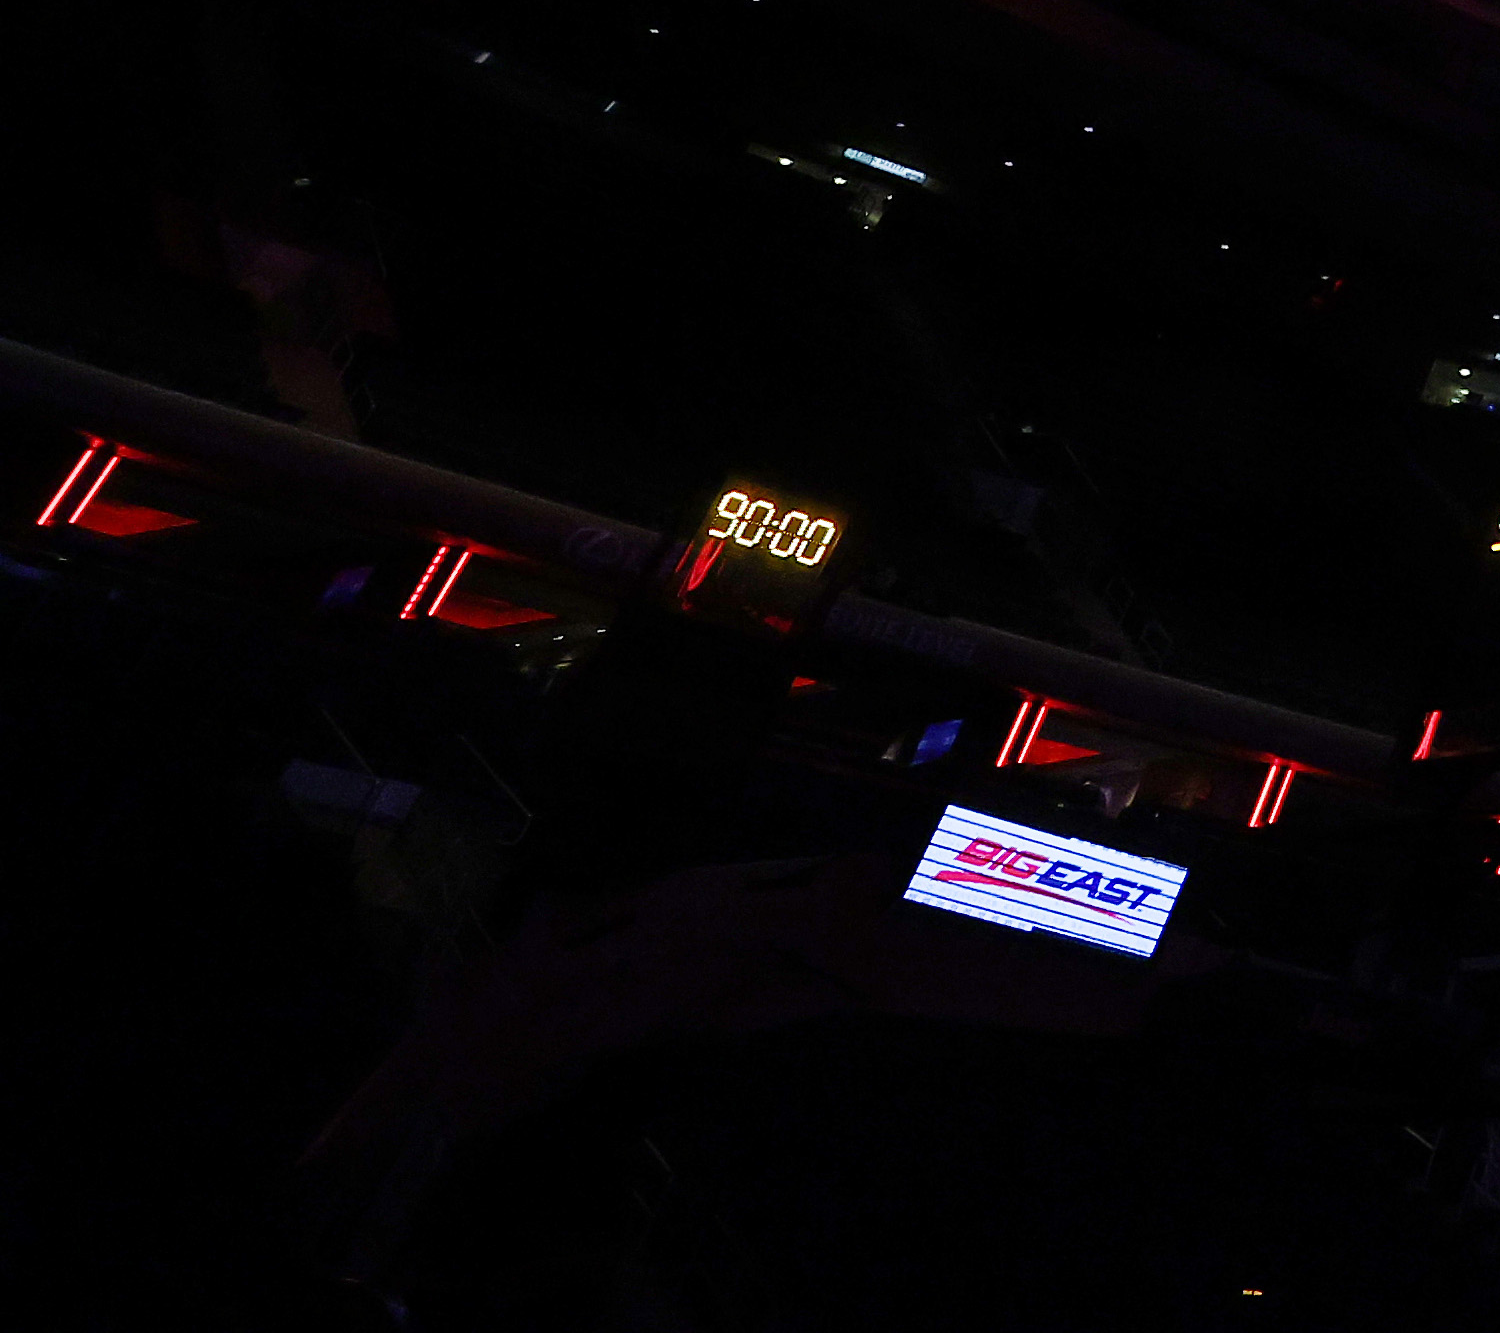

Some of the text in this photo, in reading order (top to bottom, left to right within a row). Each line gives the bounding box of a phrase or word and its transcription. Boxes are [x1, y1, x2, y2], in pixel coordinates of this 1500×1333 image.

[708, 490, 837, 567] 90:00
[954, 836, 1165, 911] BIG EAST
